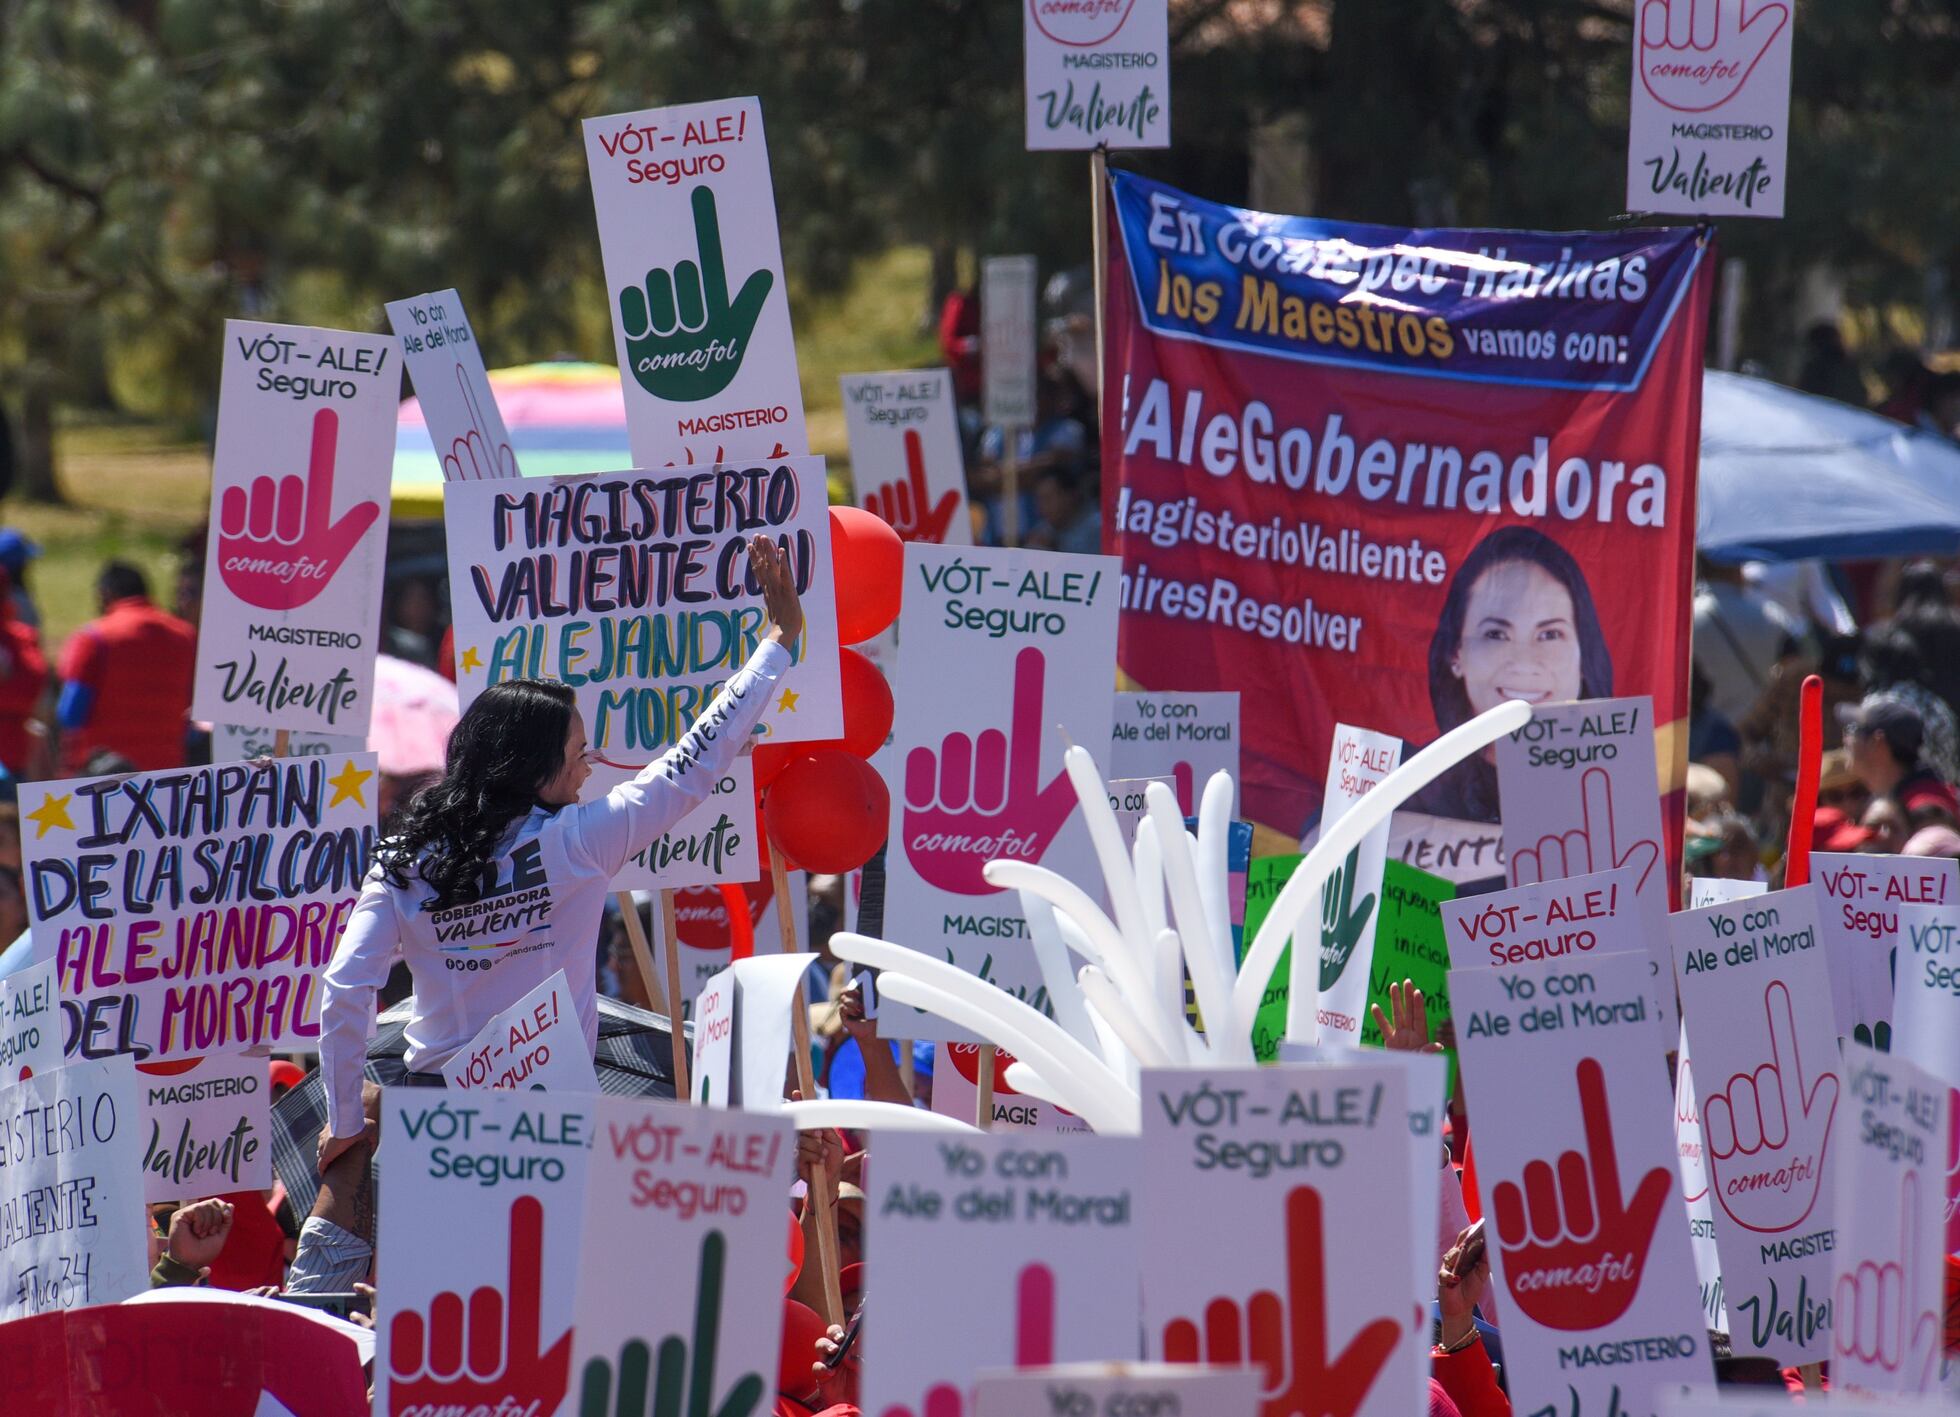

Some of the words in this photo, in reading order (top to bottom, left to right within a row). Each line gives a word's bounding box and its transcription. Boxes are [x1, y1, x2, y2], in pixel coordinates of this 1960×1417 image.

[1063, 53, 1158, 69] MAGISTERIO
[1650, 59, 1741, 84] comafol
[1038, 80, 1160, 139] Valiente
[1672, 123, 1774, 141] MAGISTERIO
[627, 153, 726, 185] Seguro
[1644, 148, 1771, 208] Valiente
[1149, 191, 1206, 257] En
[408, 306, 428, 326] Yo
[1156, 258, 1223, 324] los
[1236, 274, 1455, 359] Maestros
[1462, 327, 1557, 361] vamos
[1563, 331, 1629, 364] con:
[404, 334, 424, 355] Ale
[425, 327, 446, 350] del
[638, 338, 738, 373] comafol
[256, 368, 357, 400] Seguro
[678, 406, 788, 437] MAGISTERIO
[865, 405, 929, 426] Seguro
[493, 465, 800, 552] MAGISTERIO
[1116, 487, 1447, 585] agisterioValiente
[225, 556, 327, 584] comafol
[470, 538, 717, 624] VALIENTE
[248, 623, 362, 650] MAGISTERIO
[944, 599, 1066, 638] Seguro
[486, 606, 806, 690] ALEJANDR
[214, 650, 359, 725] Valiente
[594, 678, 773, 751] MOR
[1136, 700, 1157, 719] Yo
[1161, 702, 1198, 719] con
[242, 738, 331, 761] Seuro
[1112, 723, 1139, 742] Ale
[1144, 722, 1171, 741] del
[1176, 722, 1232, 742] Moral
[1528, 742, 1618, 769] Seguro
[75, 758, 327, 850] IXTAPAN
[630, 813, 741, 875] liente
[911, 828, 1039, 862] comafol
[30, 853, 119, 922] DE
[481, 838, 549, 899] LE
[431, 885, 551, 925] GOBERNADORA
[434, 900, 553, 943] VALIENTE
[1708, 916, 1737, 938] Yo
[1743, 908, 1779, 933] con
[1842, 903, 1899, 939] Segu
[943, 914, 1033, 940] MAGIST
[57, 897, 358, 997] ALEJANDRA
[1685, 951, 1718, 976] Ale
[1724, 937, 1759, 968] del
[1763, 924, 1816, 959] Moral
[1501, 976, 1535, 1001] Yo
[1544, 972, 1595, 996] con
[1924, 960, 1960, 997] Seg
[160, 972, 322, 1055] MORAL
[1316, 1009, 1356, 1032] GISTERIO
[1466, 1011, 1510, 1039] Ale
[1520, 1003, 1565, 1031] del
[1572, 996, 1647, 1022] Moral
[149, 1076, 258, 1106] MAGISTERIO
[428, 1147, 566, 1187] Seguro
[938, 1142, 984, 1179] Yo
[994, 1144, 1068, 1180] con
[1193, 1133, 1346, 1179] Seguro
[1728, 1155, 1815, 1196] comafol
[0, 1175, 98, 1251] ALIENTE
[629, 1169, 749, 1220] Seguro
[880, 1184, 945, 1222] Ale
[953, 1186, 1014, 1223] del
[1026, 1189, 1132, 1227] Moral
[1761, 1229, 1838, 1265] MAGISTE
[1516, 1252, 1634, 1294] comafol
[1736, 1275, 1833, 1349] Valie
[1559, 1334, 1697, 1369] MAGISTERIO
